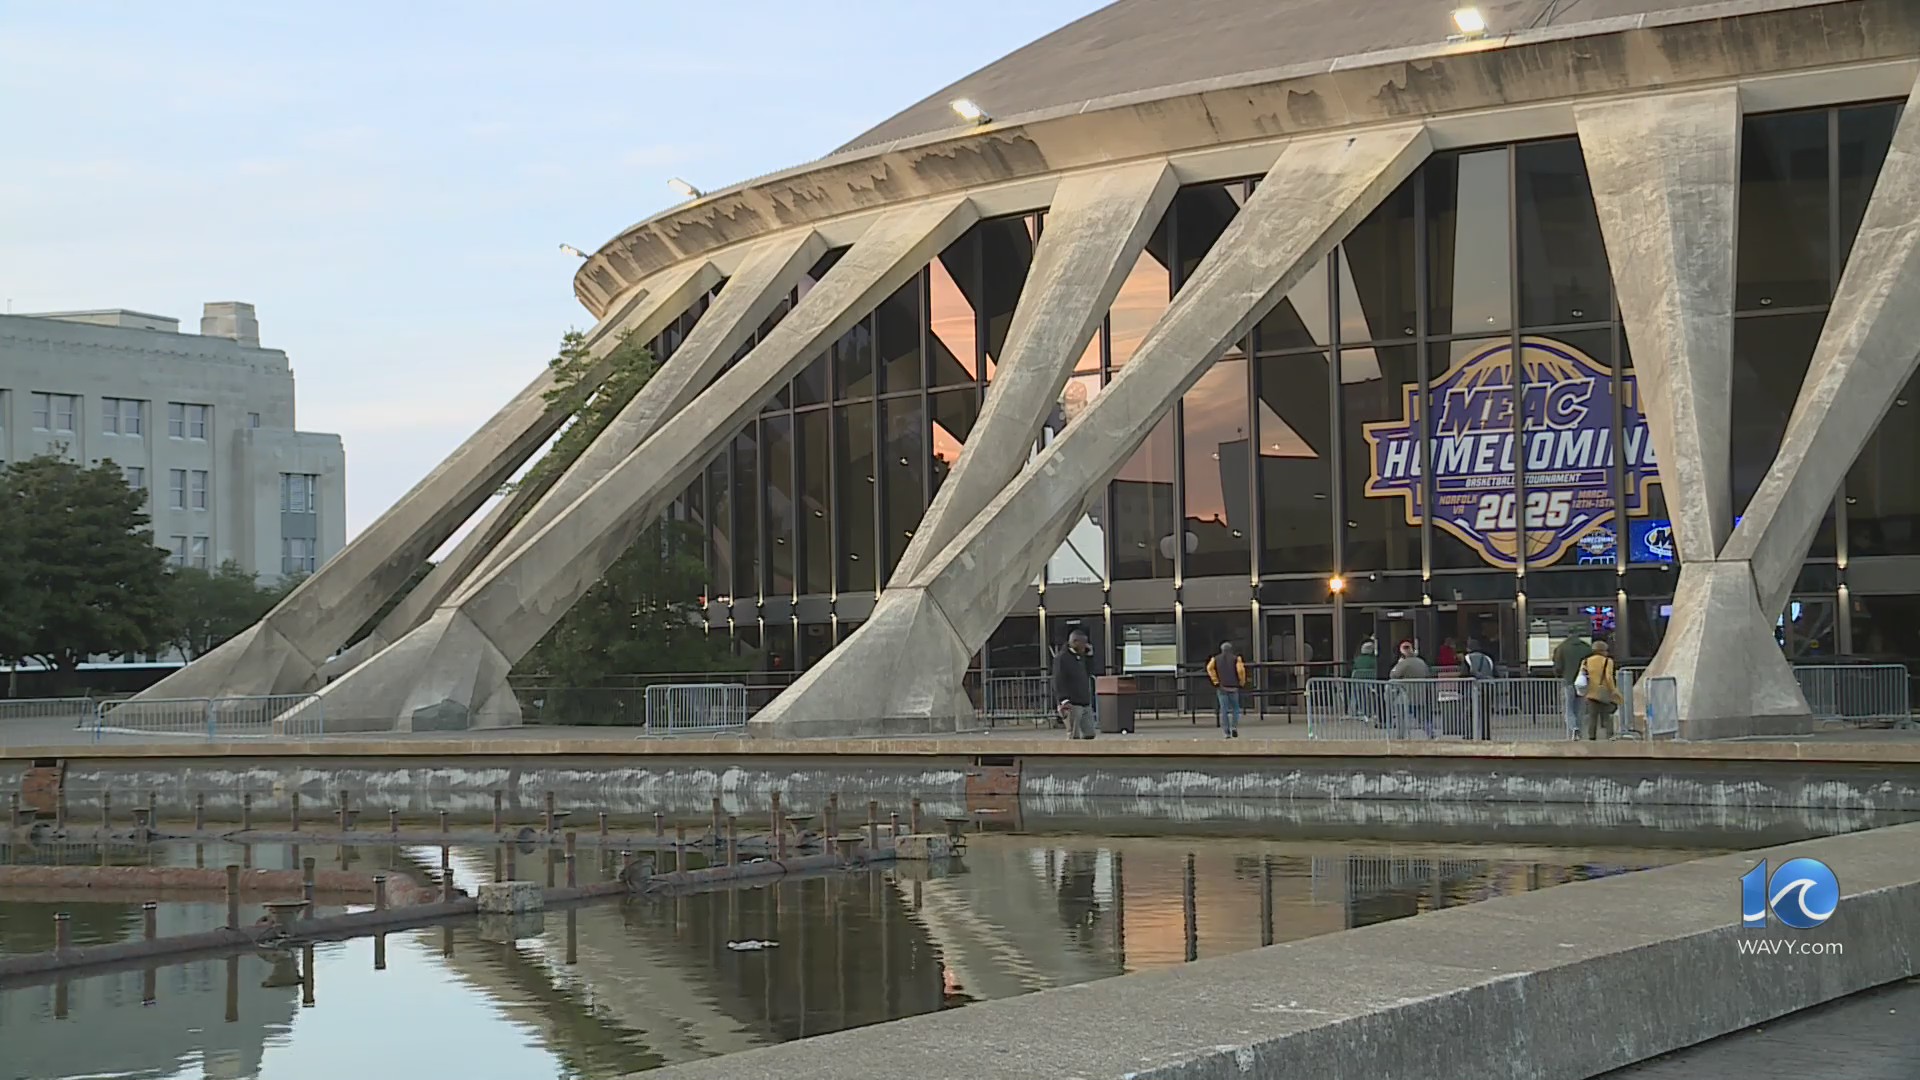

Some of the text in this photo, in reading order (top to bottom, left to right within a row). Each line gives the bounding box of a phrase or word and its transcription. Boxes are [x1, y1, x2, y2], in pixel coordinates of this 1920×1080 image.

[1436, 377, 1595, 446] MEAC
[1465, 473, 1581, 488] BASKETBALL TOURNAMENT
[1439, 494, 1478, 505] NORFOLK
[1475, 490, 1573, 530] 2025
